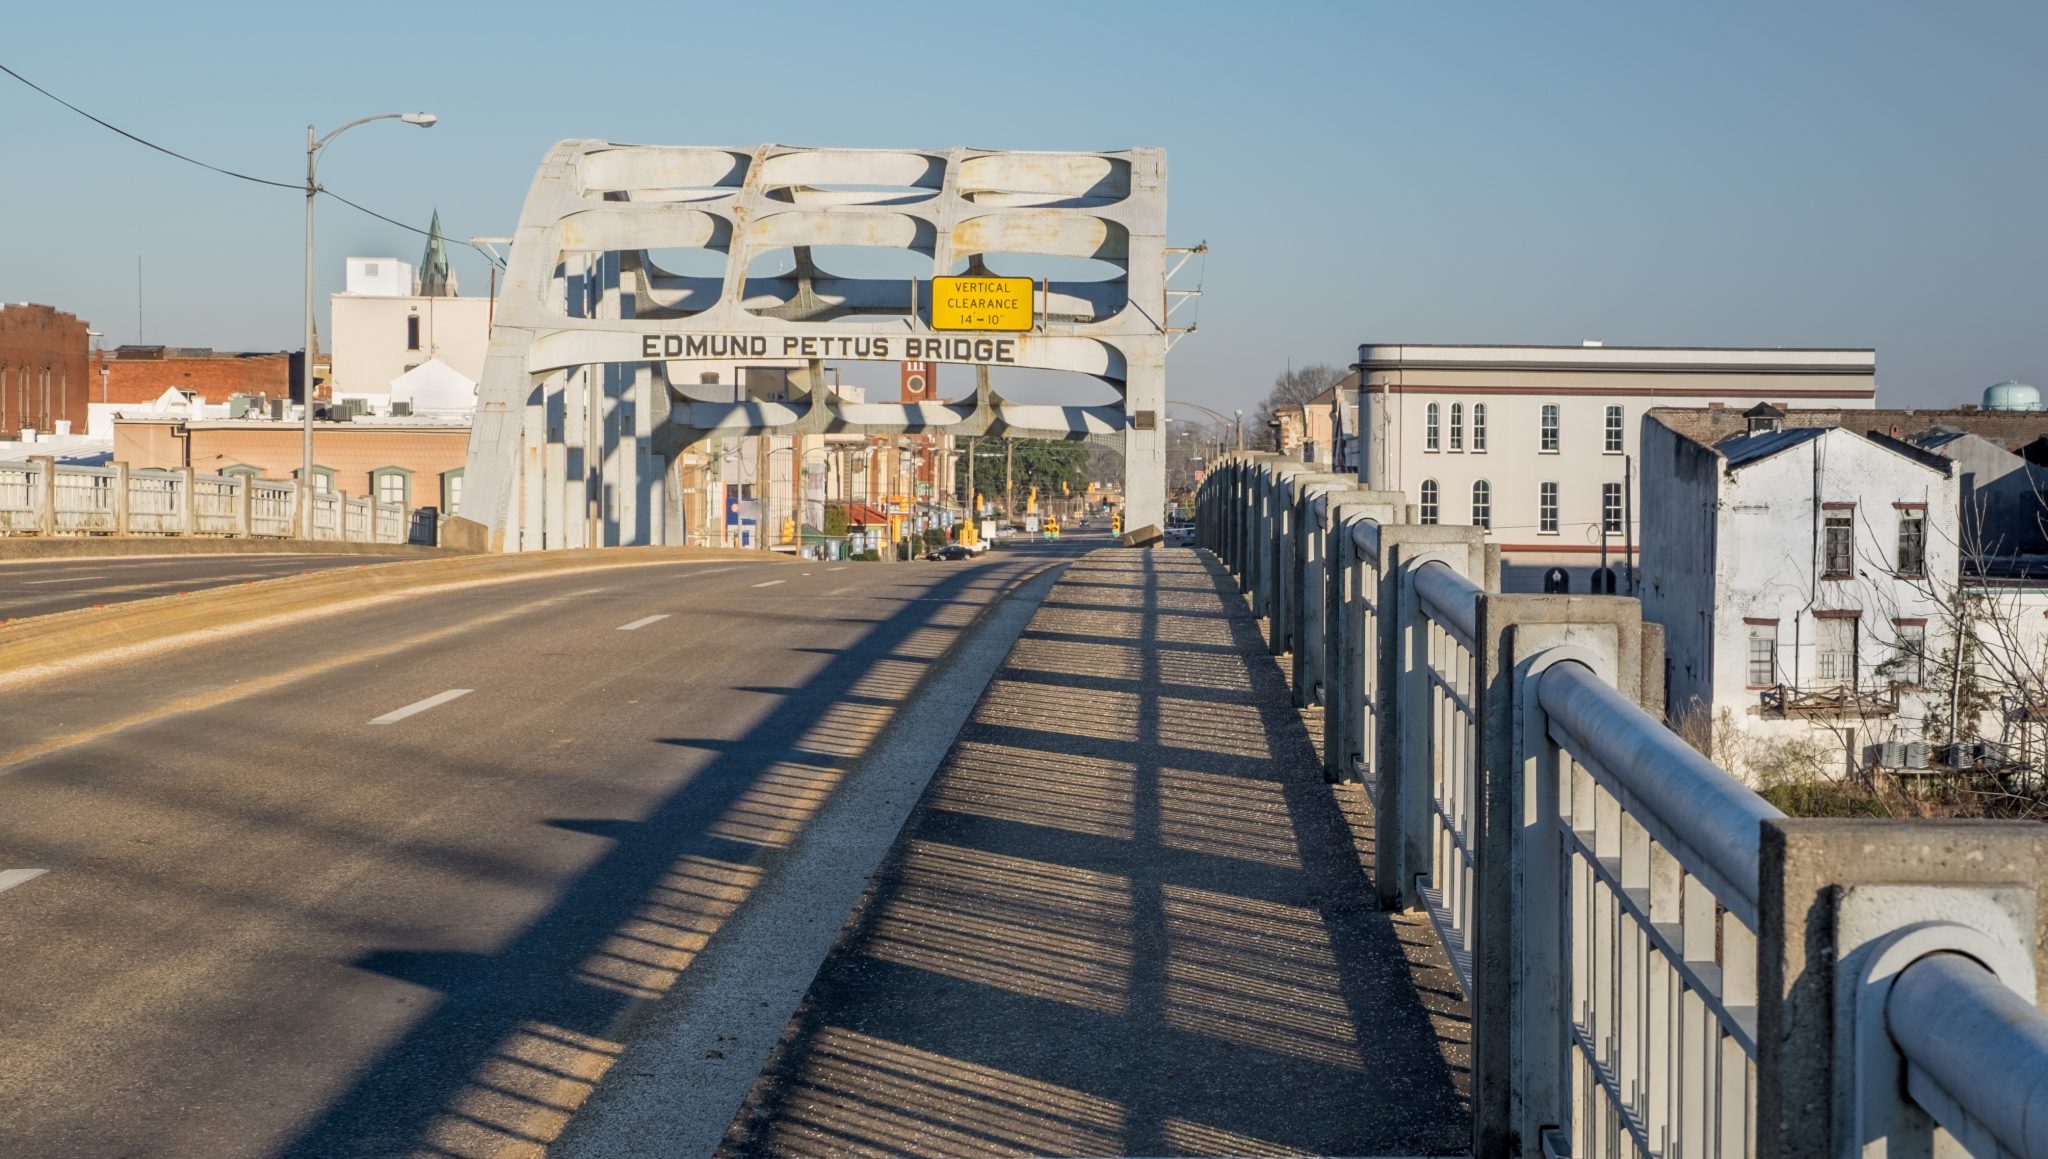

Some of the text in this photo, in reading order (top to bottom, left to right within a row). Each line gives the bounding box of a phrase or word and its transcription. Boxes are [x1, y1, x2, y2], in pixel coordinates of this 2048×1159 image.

[955, 282, 1011, 293] VERTICAL
[947, 298, 1019, 309] CLEARANCE
[642, 335, 1015, 363] EDMUND PETTUS BRIDGE
